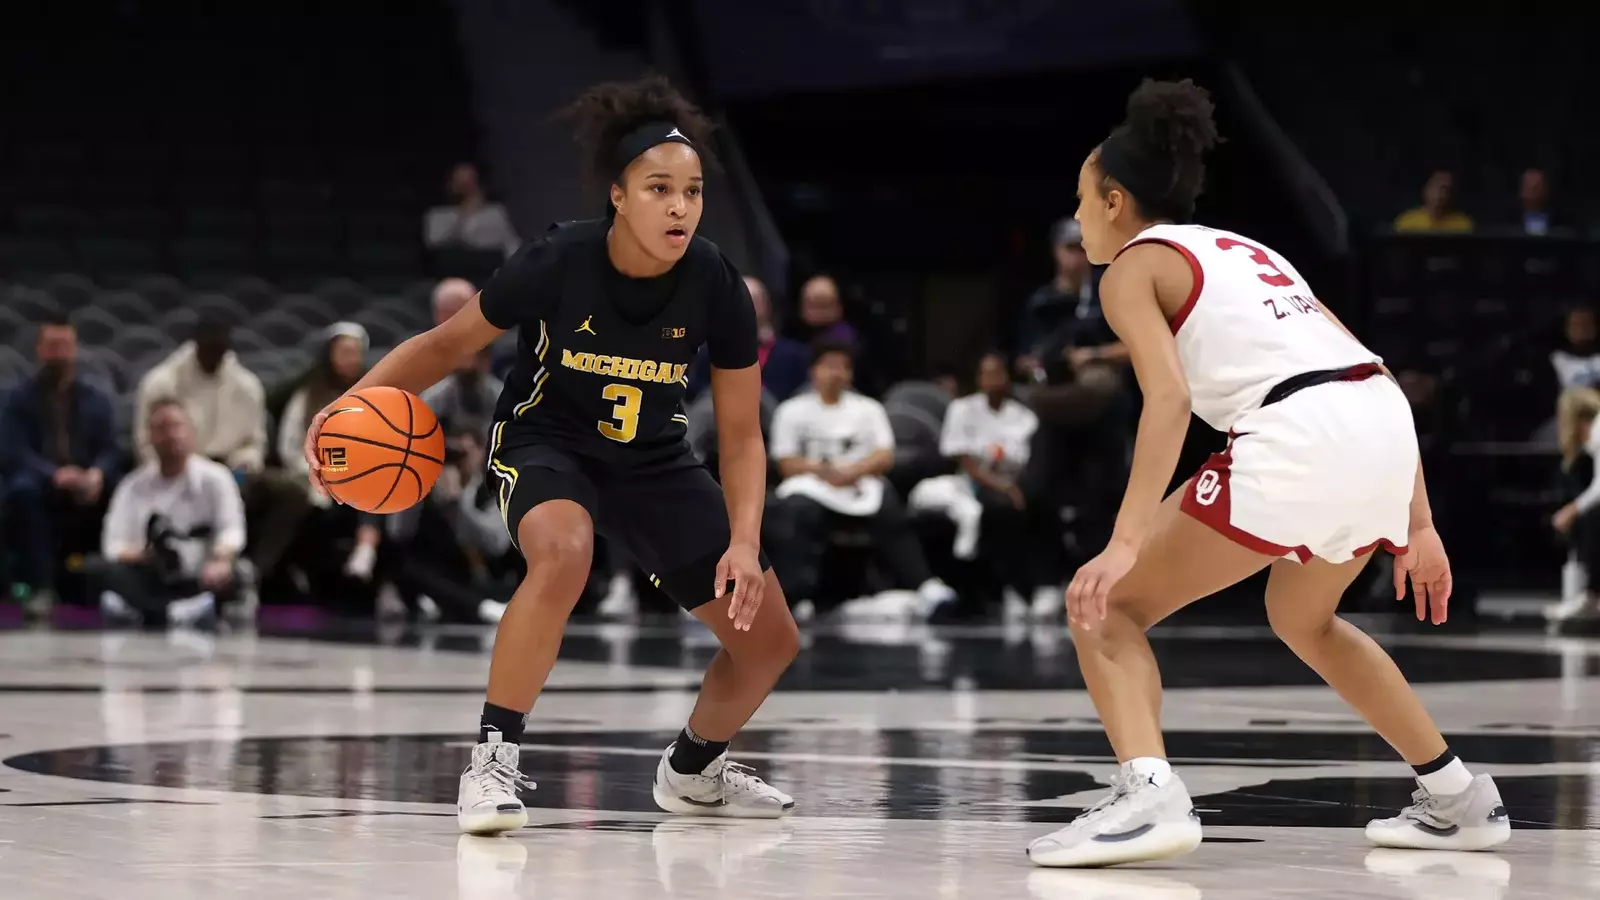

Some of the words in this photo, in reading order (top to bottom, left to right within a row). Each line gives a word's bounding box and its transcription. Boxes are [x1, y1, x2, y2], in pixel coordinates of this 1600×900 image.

[1215, 237, 1295, 287] 3
[1262, 299, 1290, 320] Z.
[561, 349, 688, 384] MICHIGAN
[597, 383, 643, 443] 3
[1196, 469, 1222, 506] OU
